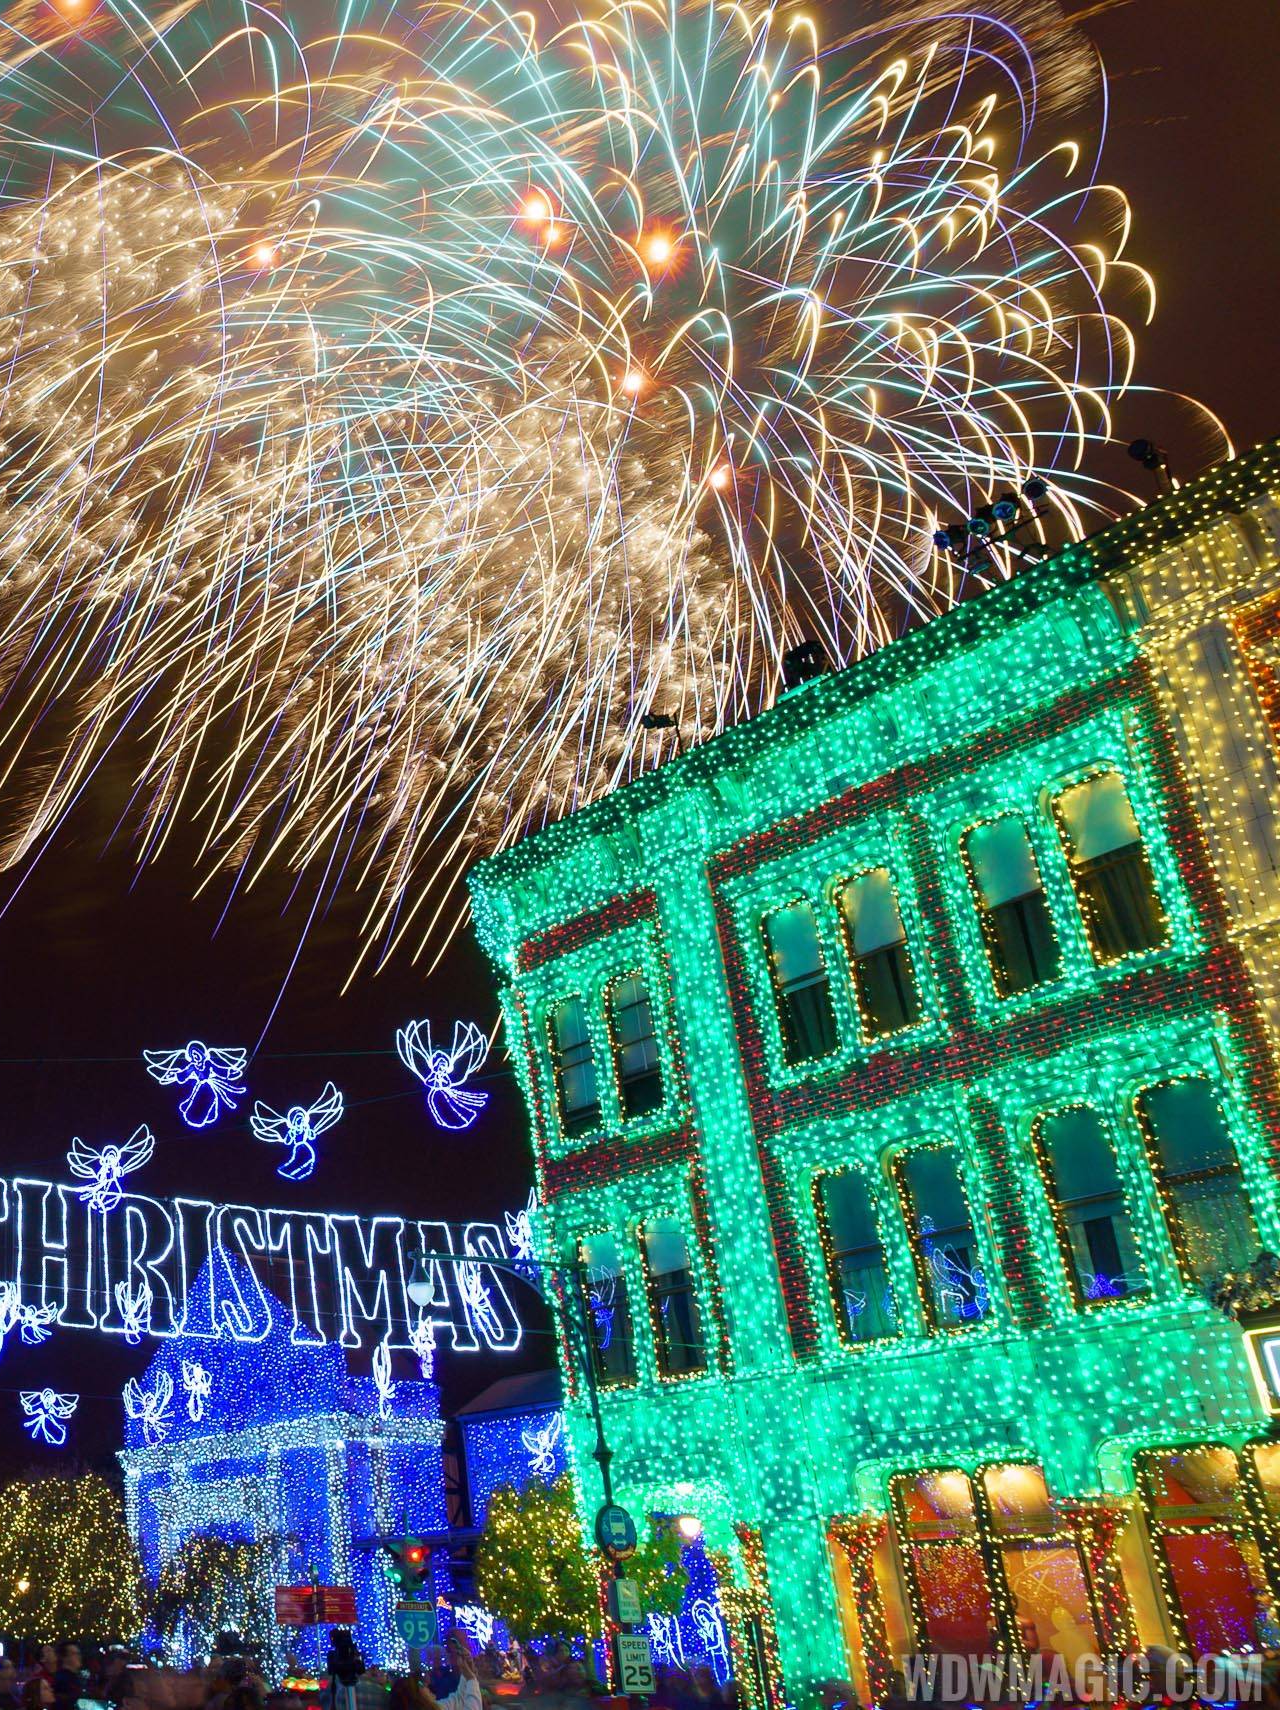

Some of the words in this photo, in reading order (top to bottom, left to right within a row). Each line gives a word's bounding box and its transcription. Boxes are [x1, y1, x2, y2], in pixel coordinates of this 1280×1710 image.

[403, 1620, 430, 1643] 95
[621, 1641, 648, 1650] SPEED
[625, 1653, 646, 1663] LIMIT
[624, 1666, 652, 1687] 25
